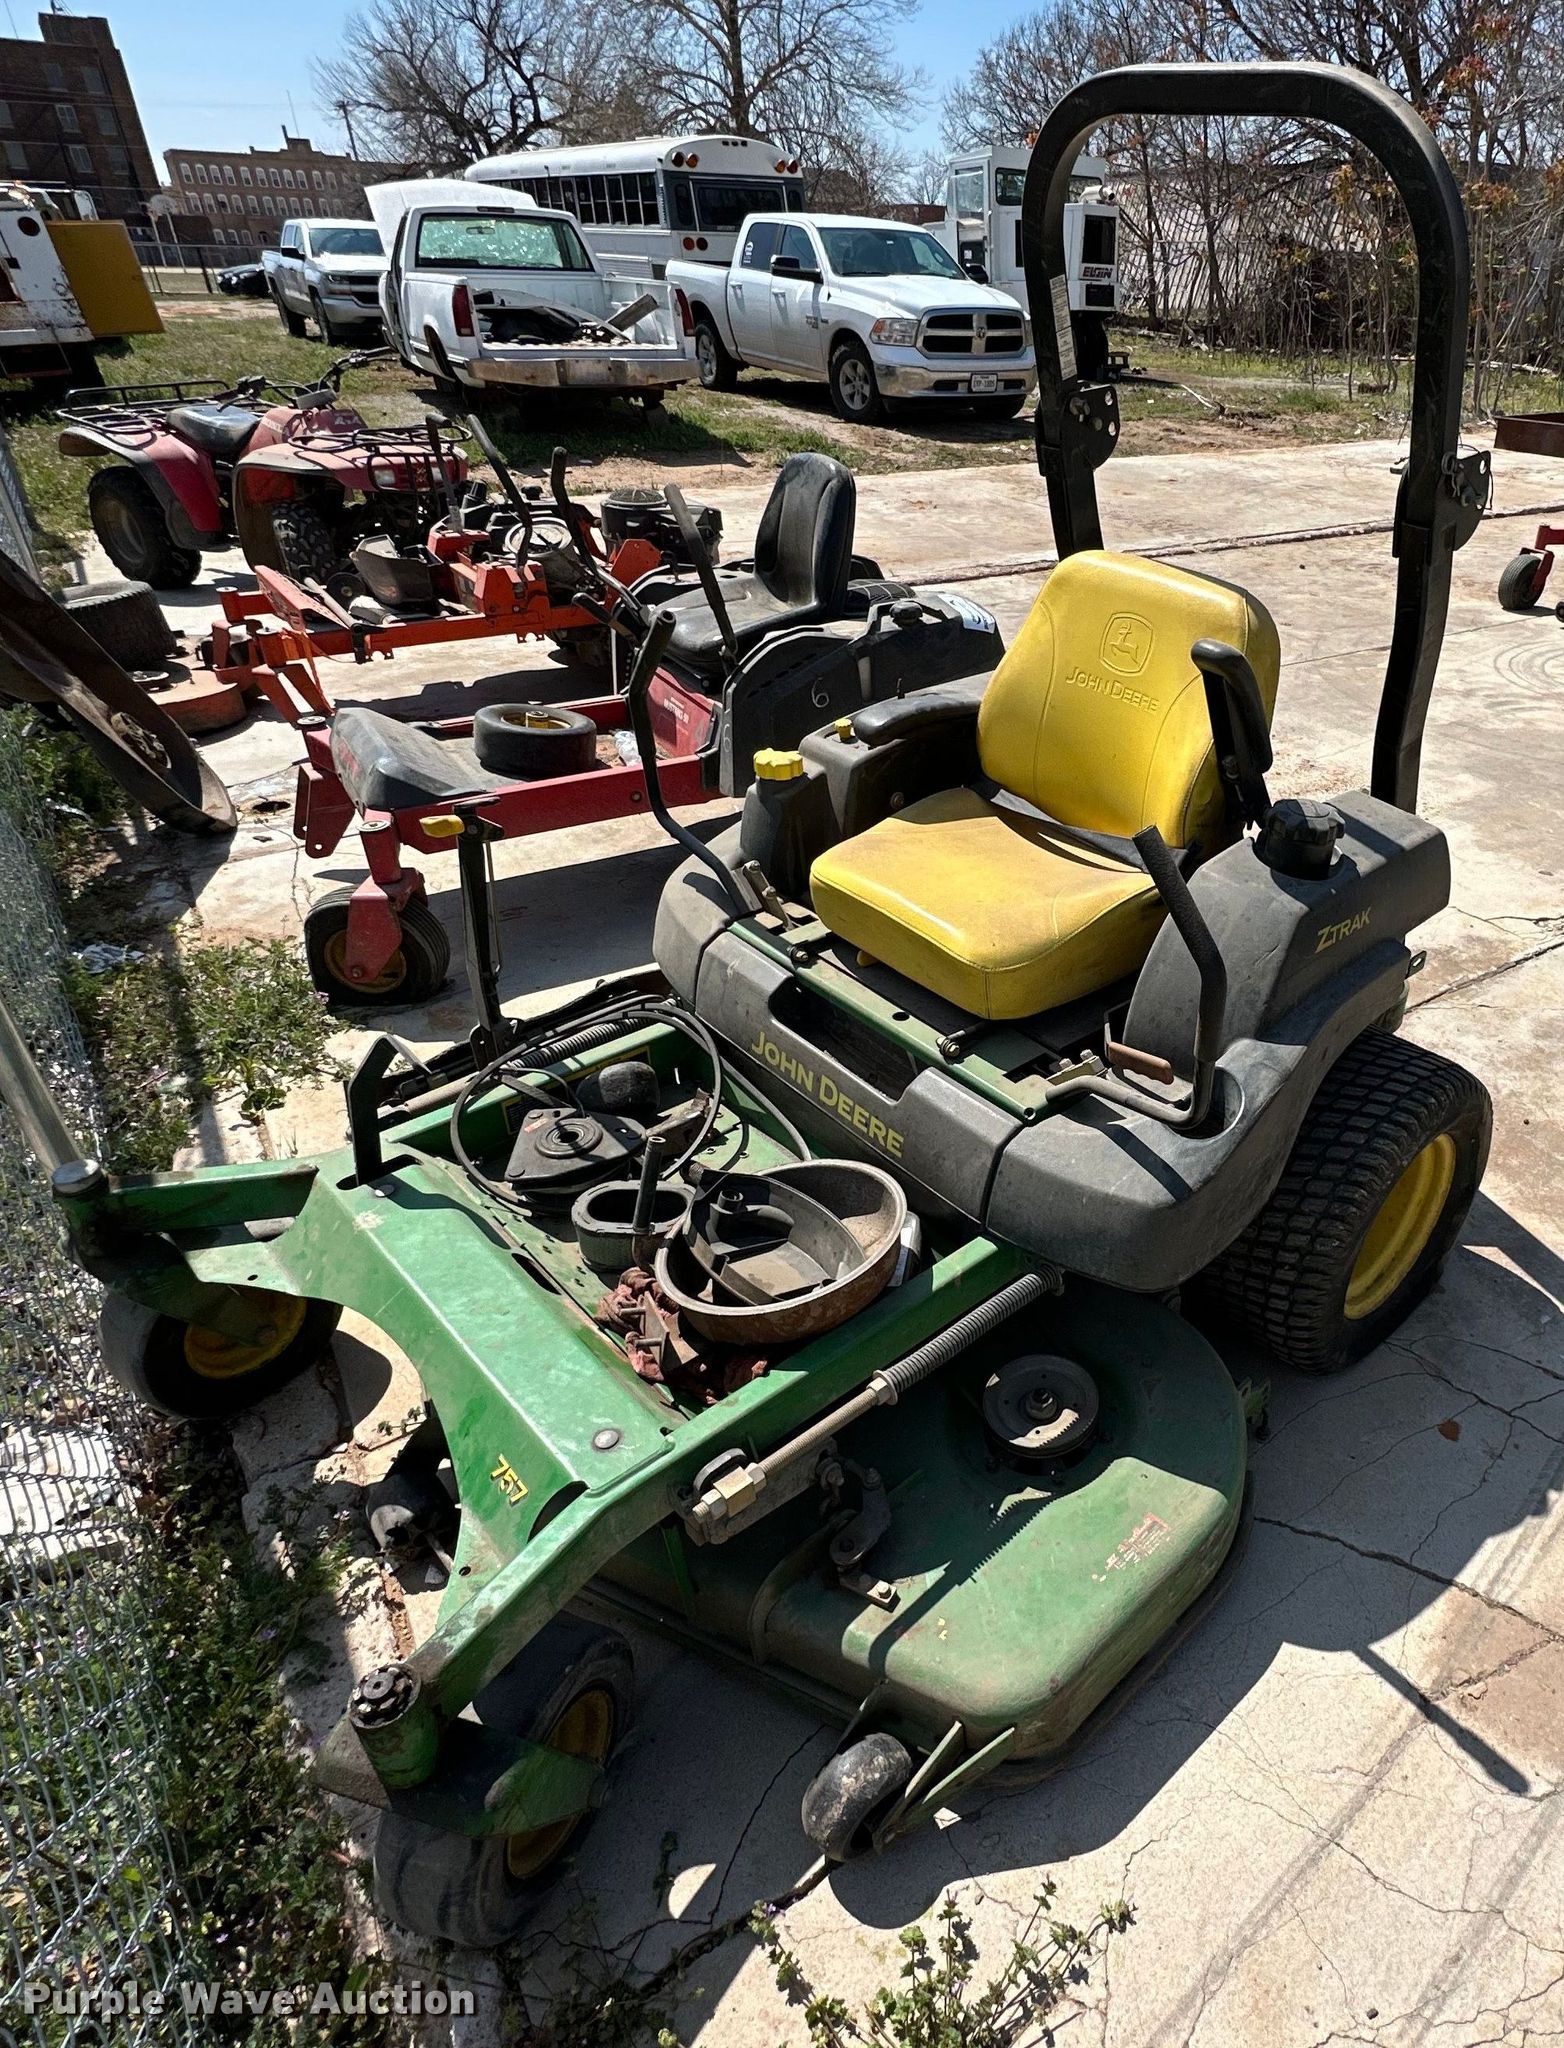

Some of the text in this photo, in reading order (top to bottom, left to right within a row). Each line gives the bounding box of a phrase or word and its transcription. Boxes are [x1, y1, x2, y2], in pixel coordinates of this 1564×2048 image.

[1082, 266, 1113, 279] ELGIN
[811, 677, 829, 708] 6
[1066, 666, 1160, 714] JOHN DEERE
[1315, 906, 1372, 954] ZTRAK
[751, 1031, 905, 1158] JOHN DEERE
[490, 1453, 529, 1507] 757
